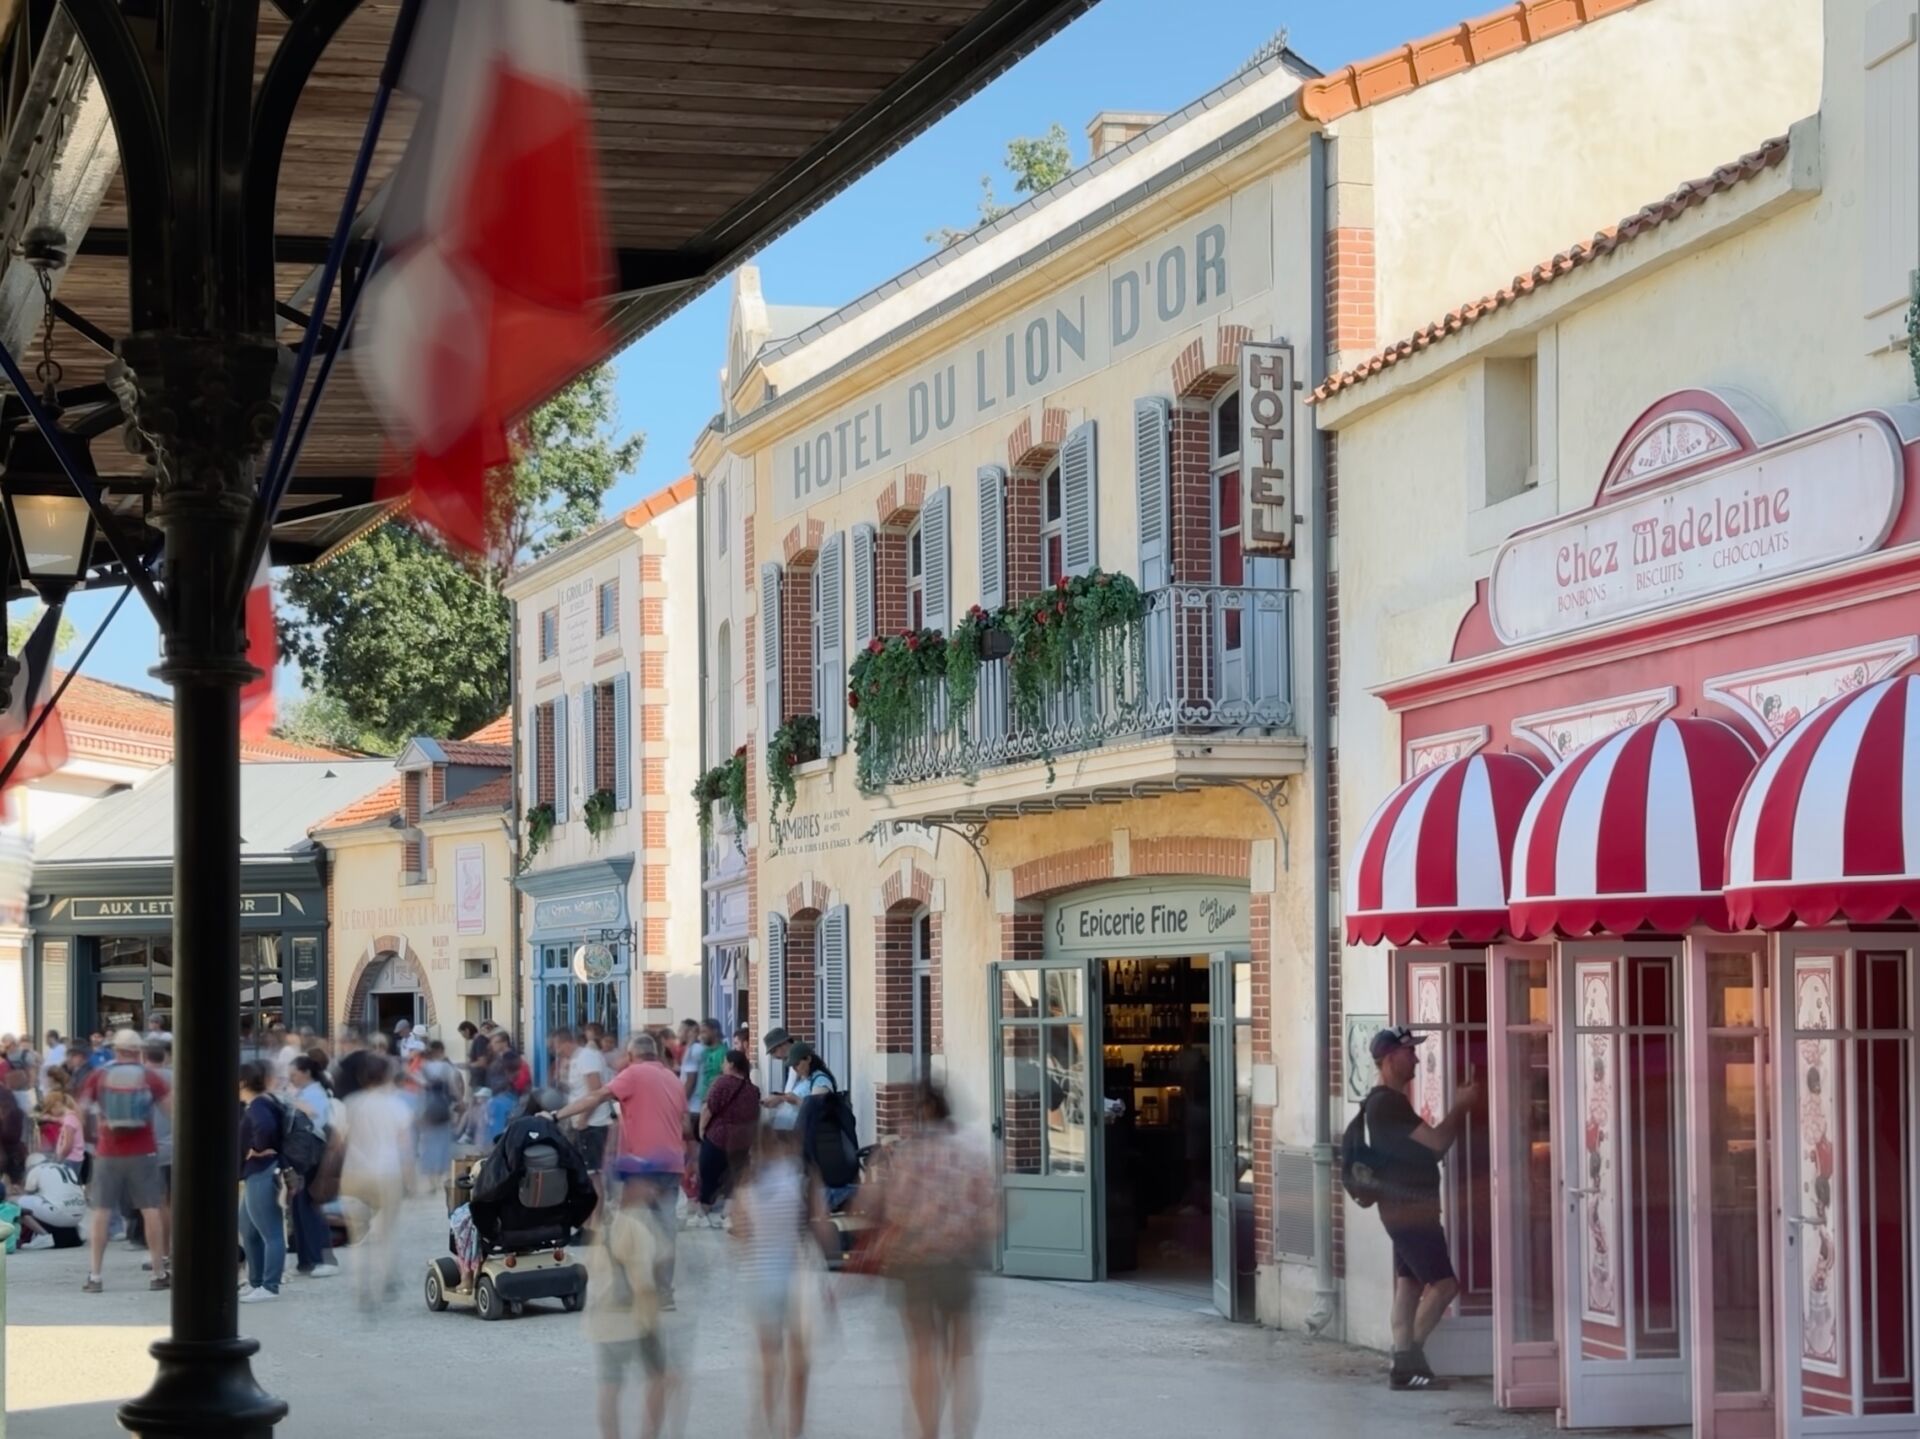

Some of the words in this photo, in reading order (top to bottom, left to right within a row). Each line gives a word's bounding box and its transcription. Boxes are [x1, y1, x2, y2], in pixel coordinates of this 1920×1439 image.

[794, 403, 892, 500] HOTEL
[909, 364, 956, 446] DU
[976, 295, 1086, 413] LION
[1112, 223, 1227, 348] D'OR
[1250, 353, 1285, 543] HOTEL
[1555, 541, 1619, 588] Chez
[1631, 487, 1791, 567] Madeleine
[1557, 583, 1607, 613] BONBONS
[1635, 561, 1685, 592] BISCUITS
[1712, 531, 1790, 570] CHOCOLATS
[99, 902, 134, 914] AUX
[140, 901, 174, 913] LETT
[1079, 906, 1145, 938] Epicerie
[1151, 904, 1188, 934] Fine
